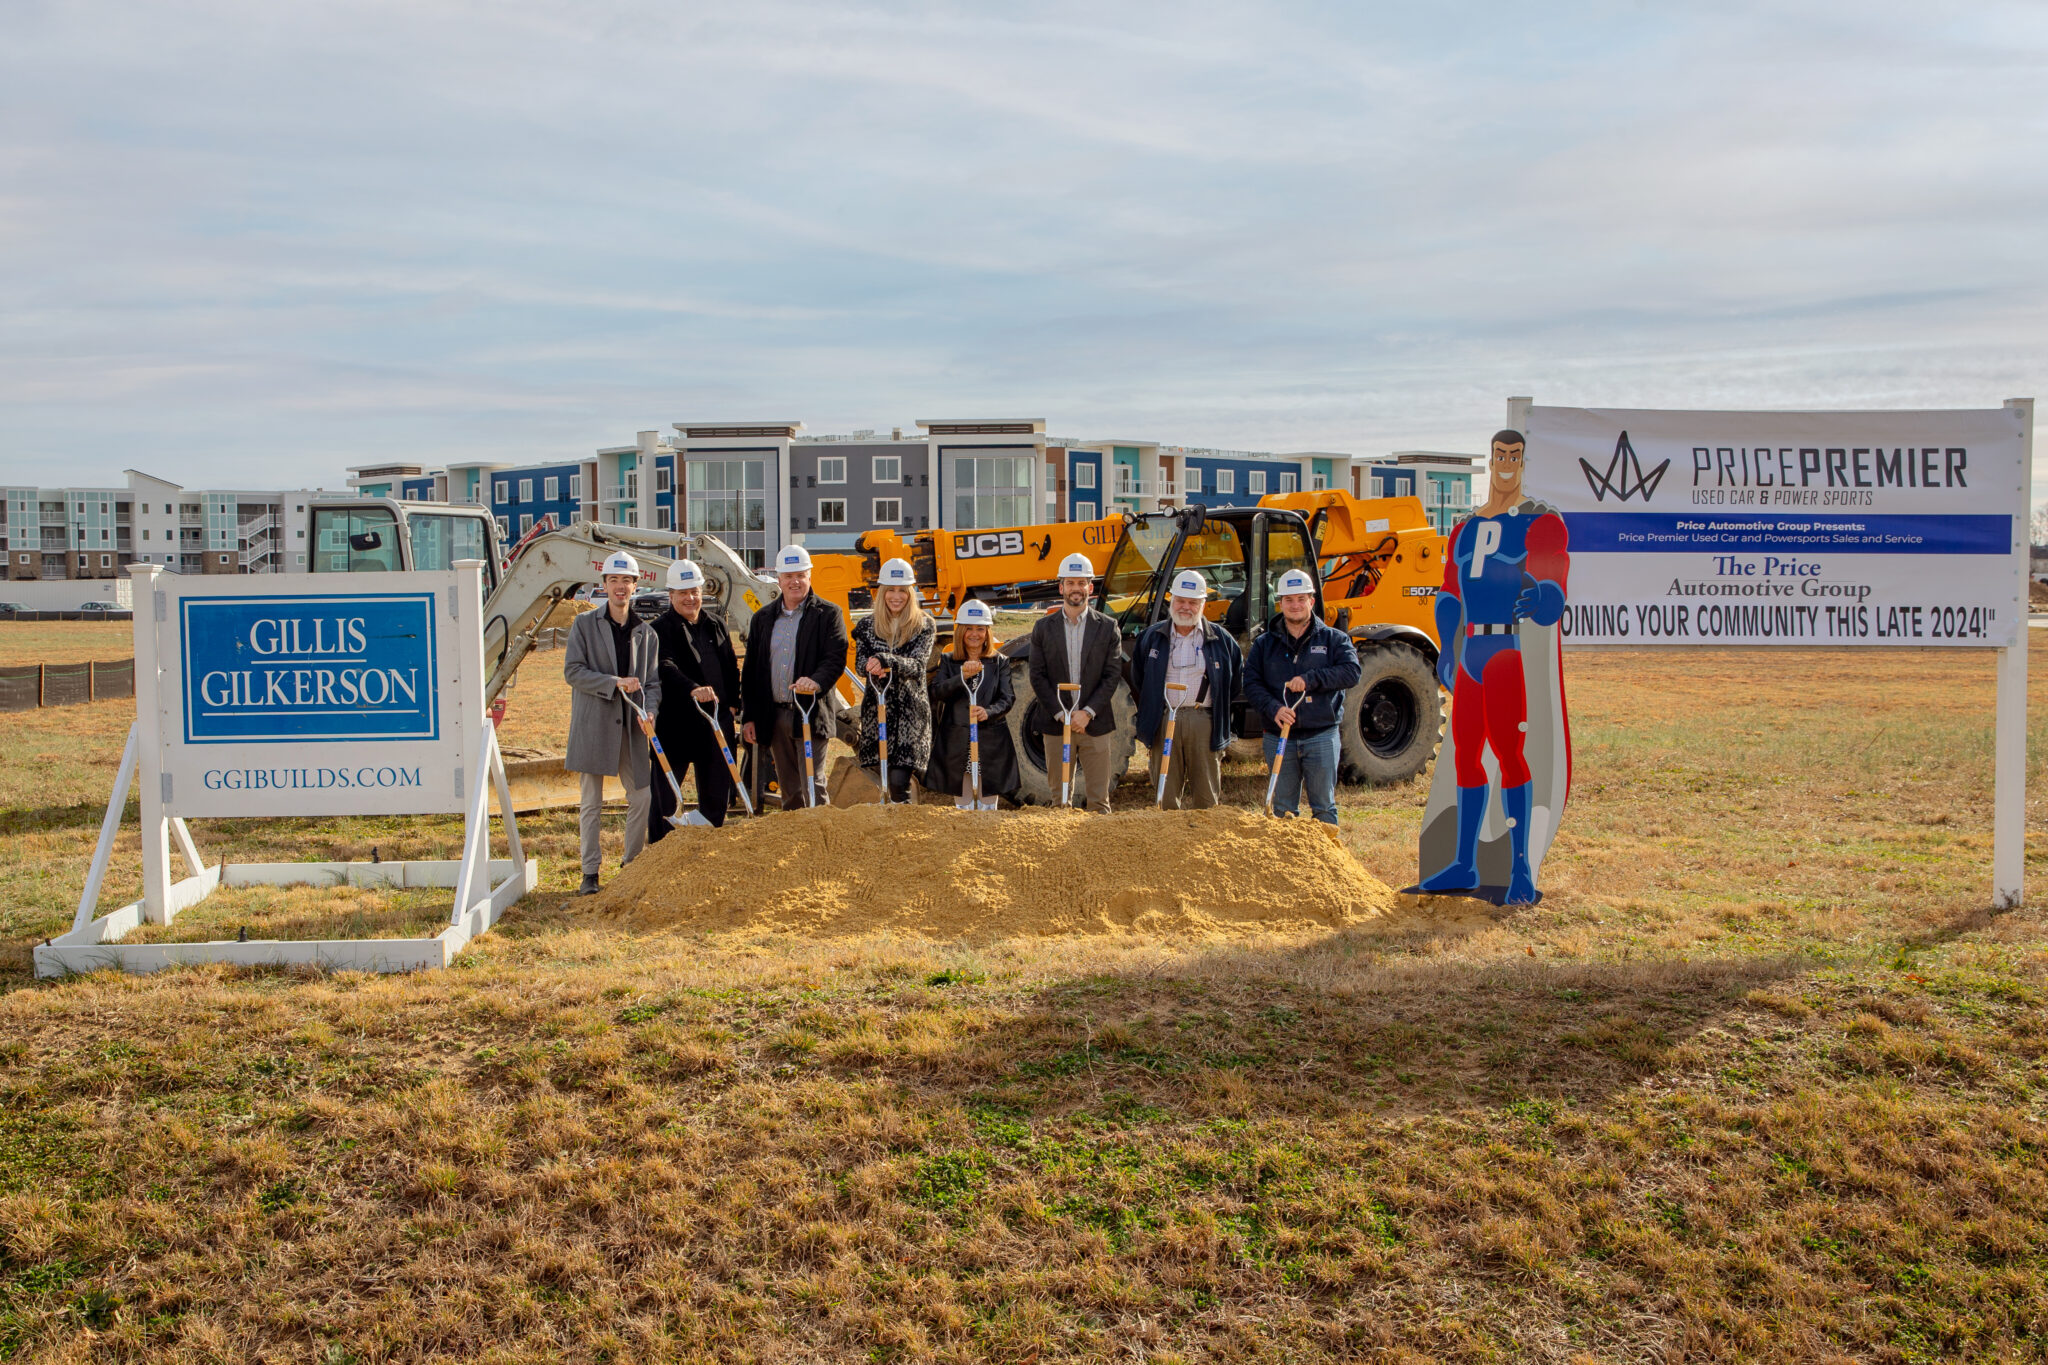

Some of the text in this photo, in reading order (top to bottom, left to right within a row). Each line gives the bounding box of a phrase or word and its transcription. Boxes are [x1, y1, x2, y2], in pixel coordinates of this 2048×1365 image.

[1692, 489, 1873, 506] USED CAR & POWER SPORTS
[1618, 533, 1923, 544] Price Premier Used Car and Powersports Sales and Service
[1676, 520, 1866, 533] Price Automotive Group Presents:
[956, 532, 1023, 558] JCB
[1470, 521, 1502, 578] P
[1712, 555, 1822, 577] The Price
[1665, 577, 1872, 603] Automotive Group
[1560, 604, 1996, 638] OINING YOUR COMMUNITY THIS LATE 2024!"
[250, 617, 367, 655] GILLIS
[201, 668, 418, 707] GILKERSON
[204, 767, 423, 790] GGIBUILDS.COM
